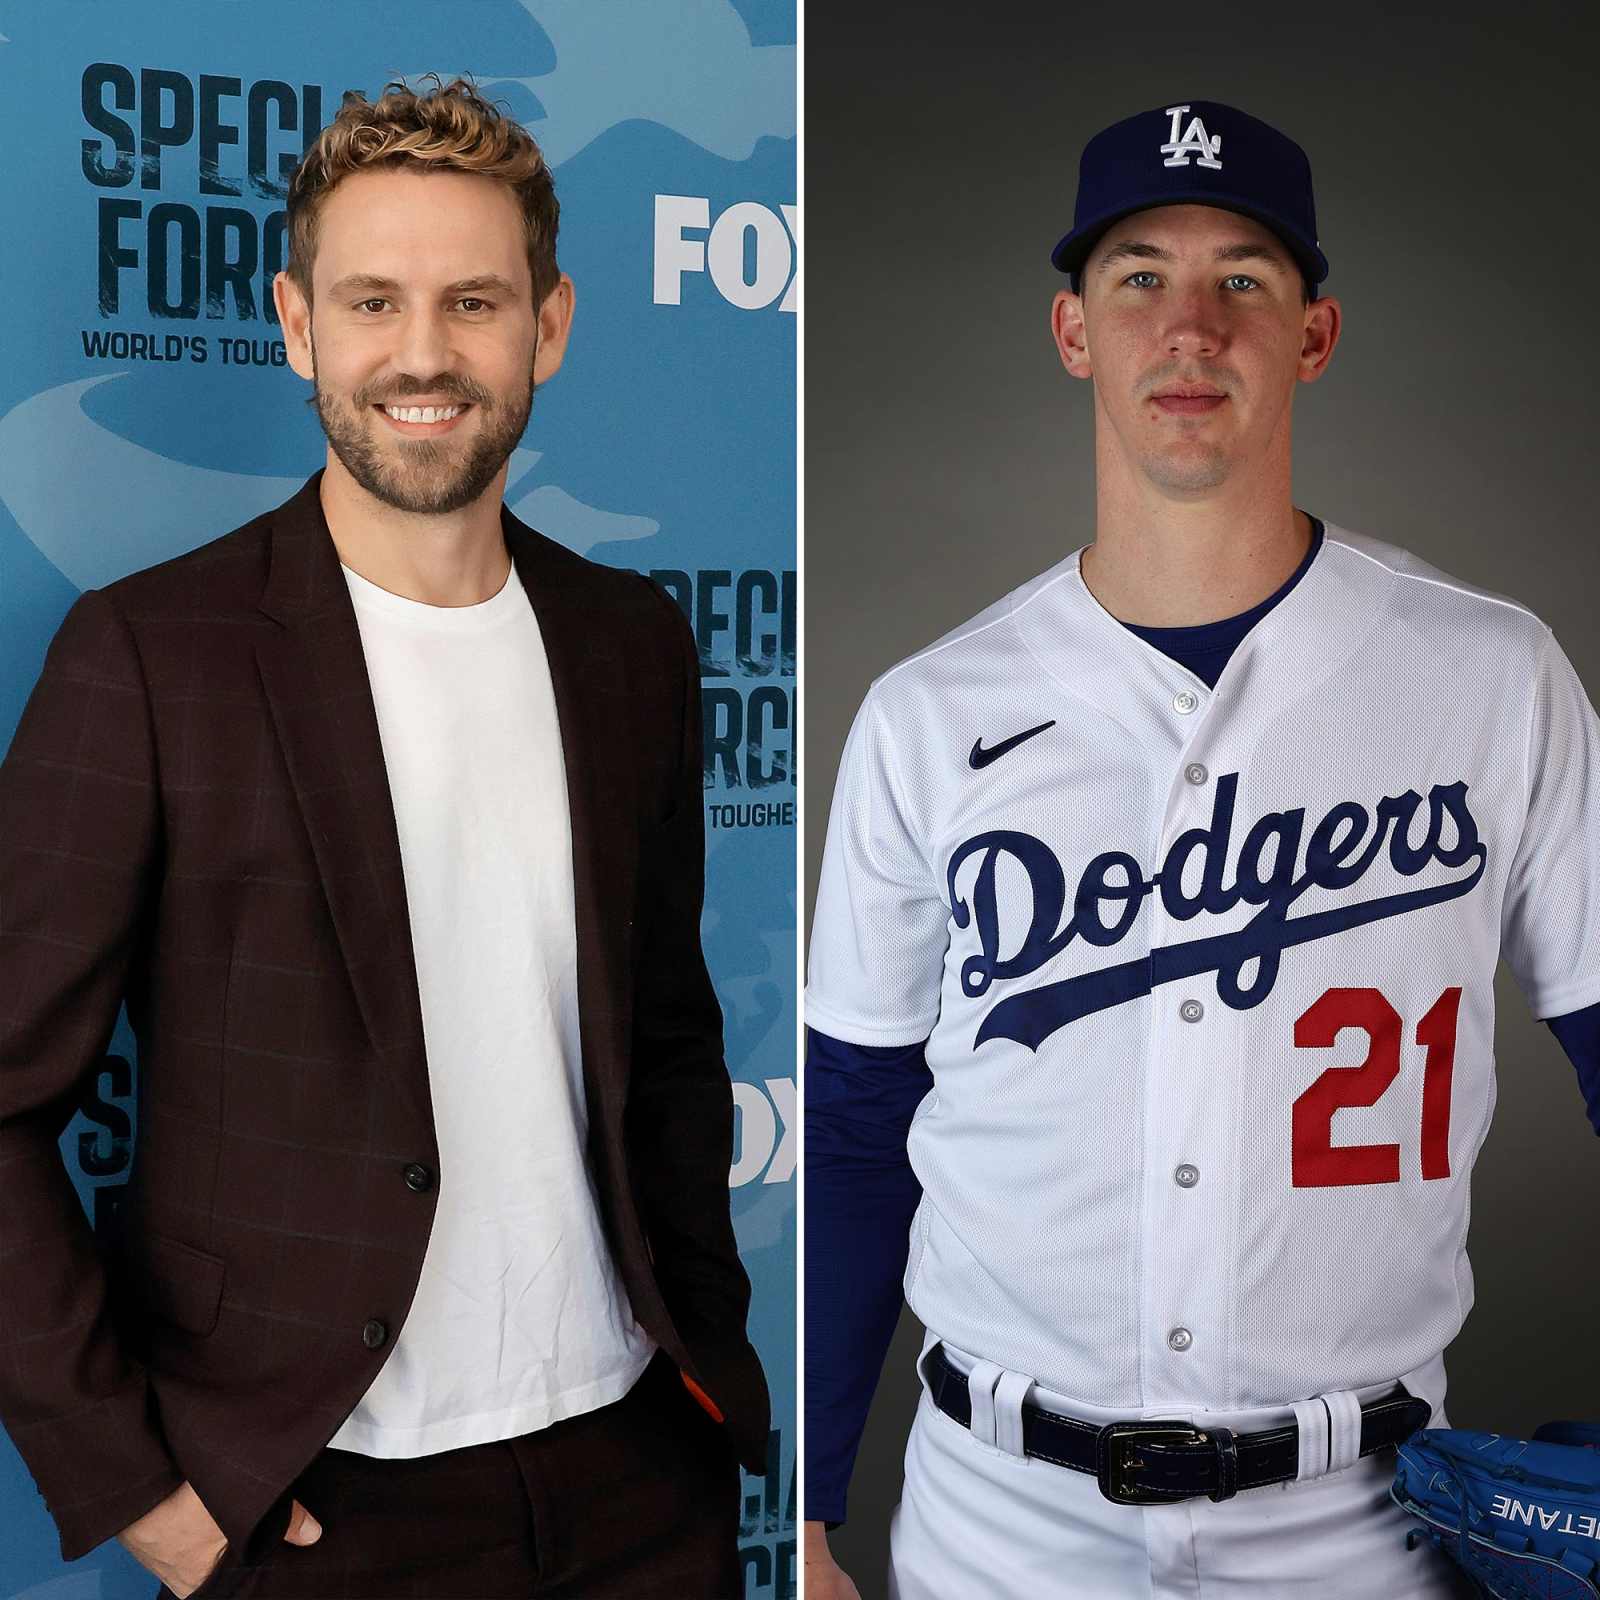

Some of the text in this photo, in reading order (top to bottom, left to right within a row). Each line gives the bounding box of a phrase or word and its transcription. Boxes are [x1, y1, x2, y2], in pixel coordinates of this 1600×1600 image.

[1160, 105, 1223, 170] LA
[653, 194, 797, 312] FO
[81, 331, 207, 364] WORLD'S
[709, 802, 797, 828] TOUGHE
[947, 771, 1488, 1055] Dodgers
[1292, 986, 1462, 1187] 21
[1489, 1494, 1600, 1540] ETANE
